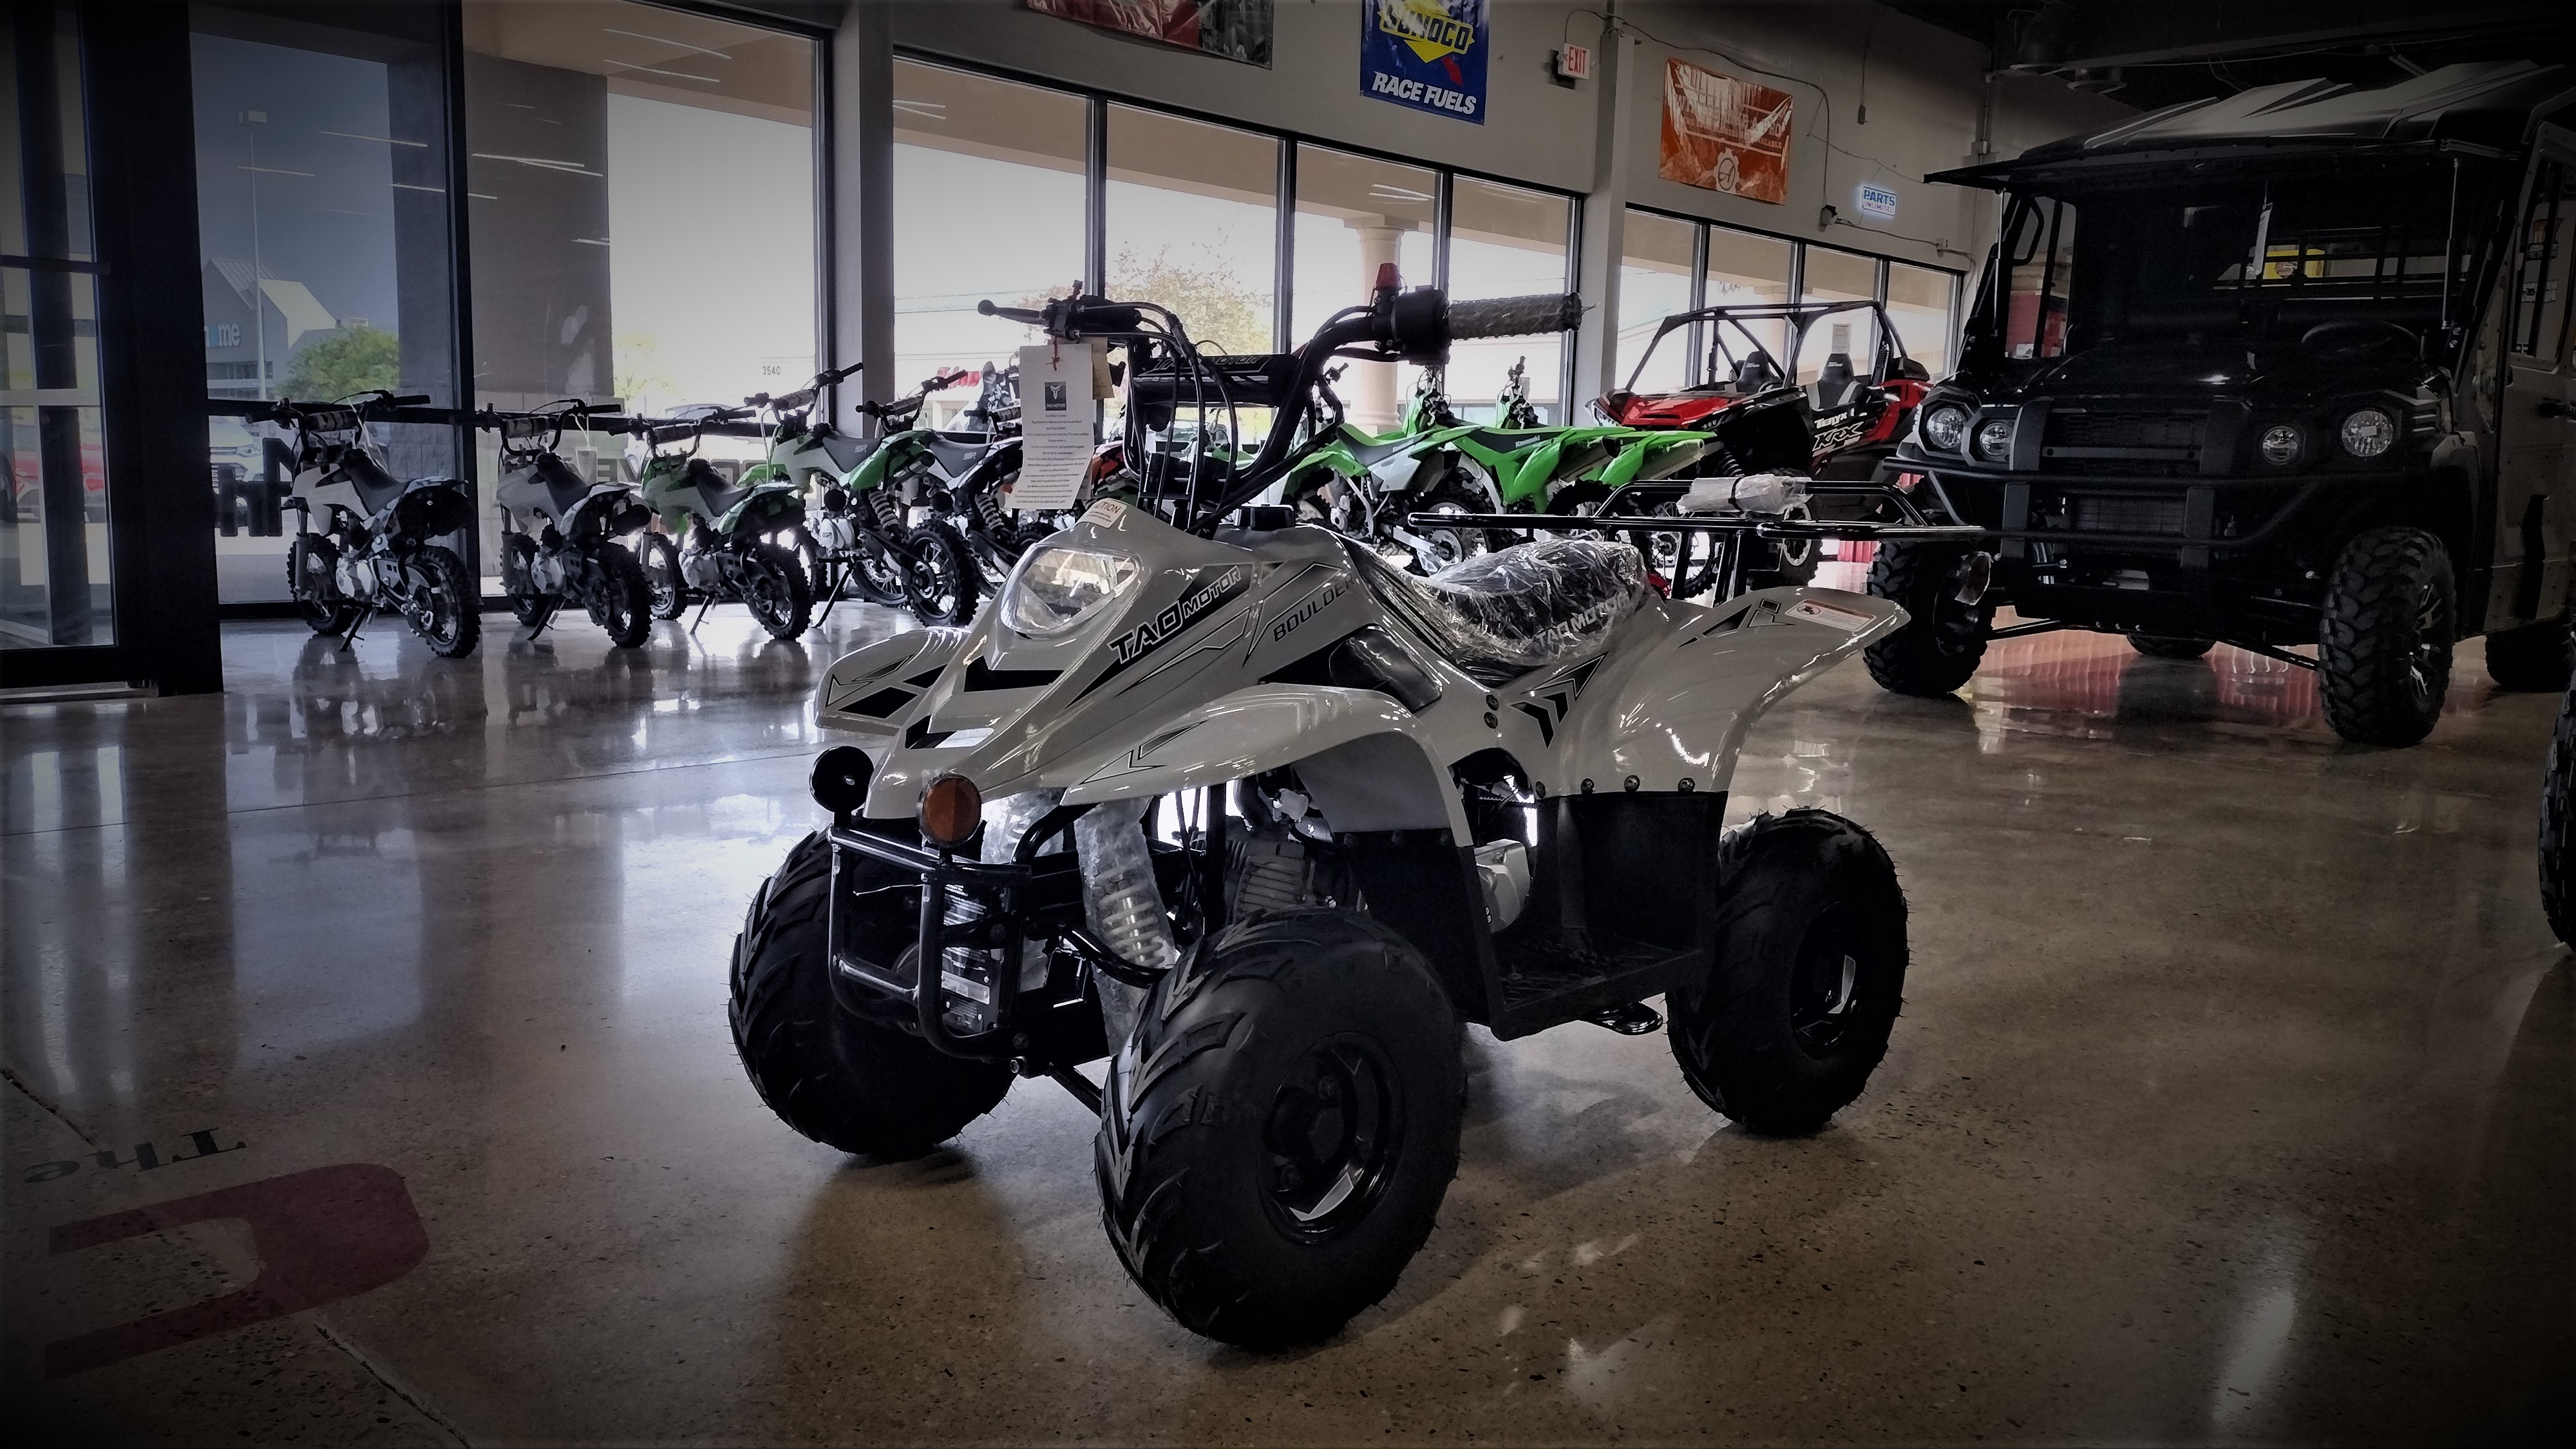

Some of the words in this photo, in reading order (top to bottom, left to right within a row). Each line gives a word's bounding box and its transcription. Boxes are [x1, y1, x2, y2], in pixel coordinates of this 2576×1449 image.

[1568, 46, 1587, 75] EXIT
[1372, 71, 1424, 101] RACE
[1424, 84, 1477, 115] FUELS
[1864, 189, 1895, 206] PARTS
[762, 365, 781, 375] 3540
[1107, 600, 1182, 664] TAO
[1183, 565, 1242, 620] MOTOR
[1273, 573, 1357, 643] BOULDER
[1535, 621, 1572, 648] TAO
[21, 1127, 247, 1183] The
